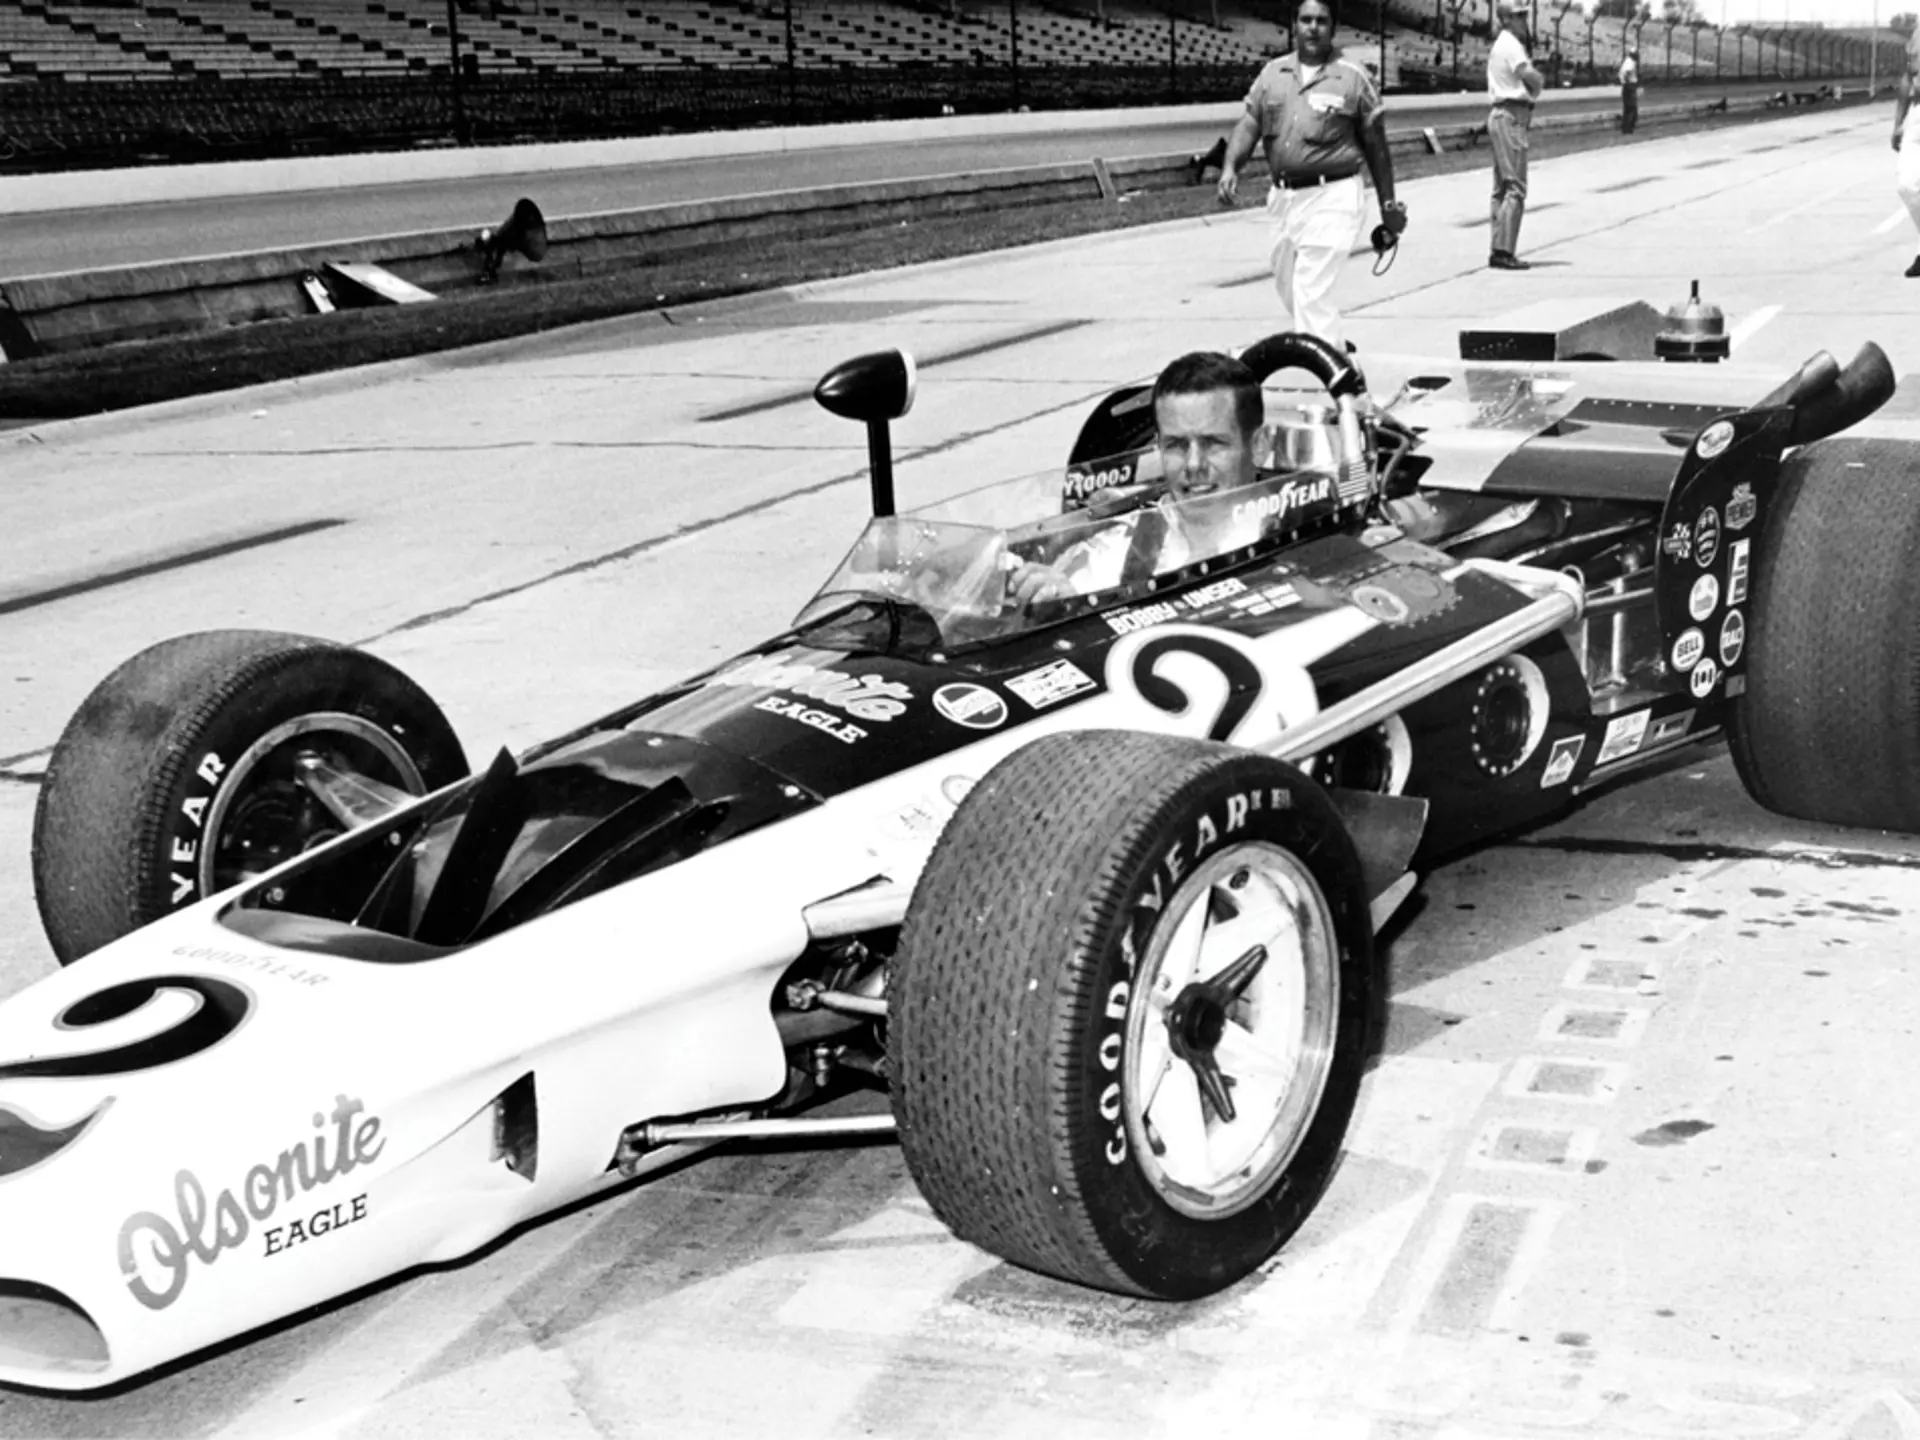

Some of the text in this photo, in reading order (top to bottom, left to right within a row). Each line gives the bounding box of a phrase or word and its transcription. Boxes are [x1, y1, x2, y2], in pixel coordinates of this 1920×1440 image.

[1232, 478, 1330, 523] GOODYEAR
[1107, 602, 1178, 635] BOBBY
[1132, 633, 1264, 741] 2
[754, 697, 866, 742] EAGLE
[171, 945, 330, 986] GOODYEAR
[117, 1093, 387, 1312] Olsonite
[264, 1193, 368, 1257] EAGLE
